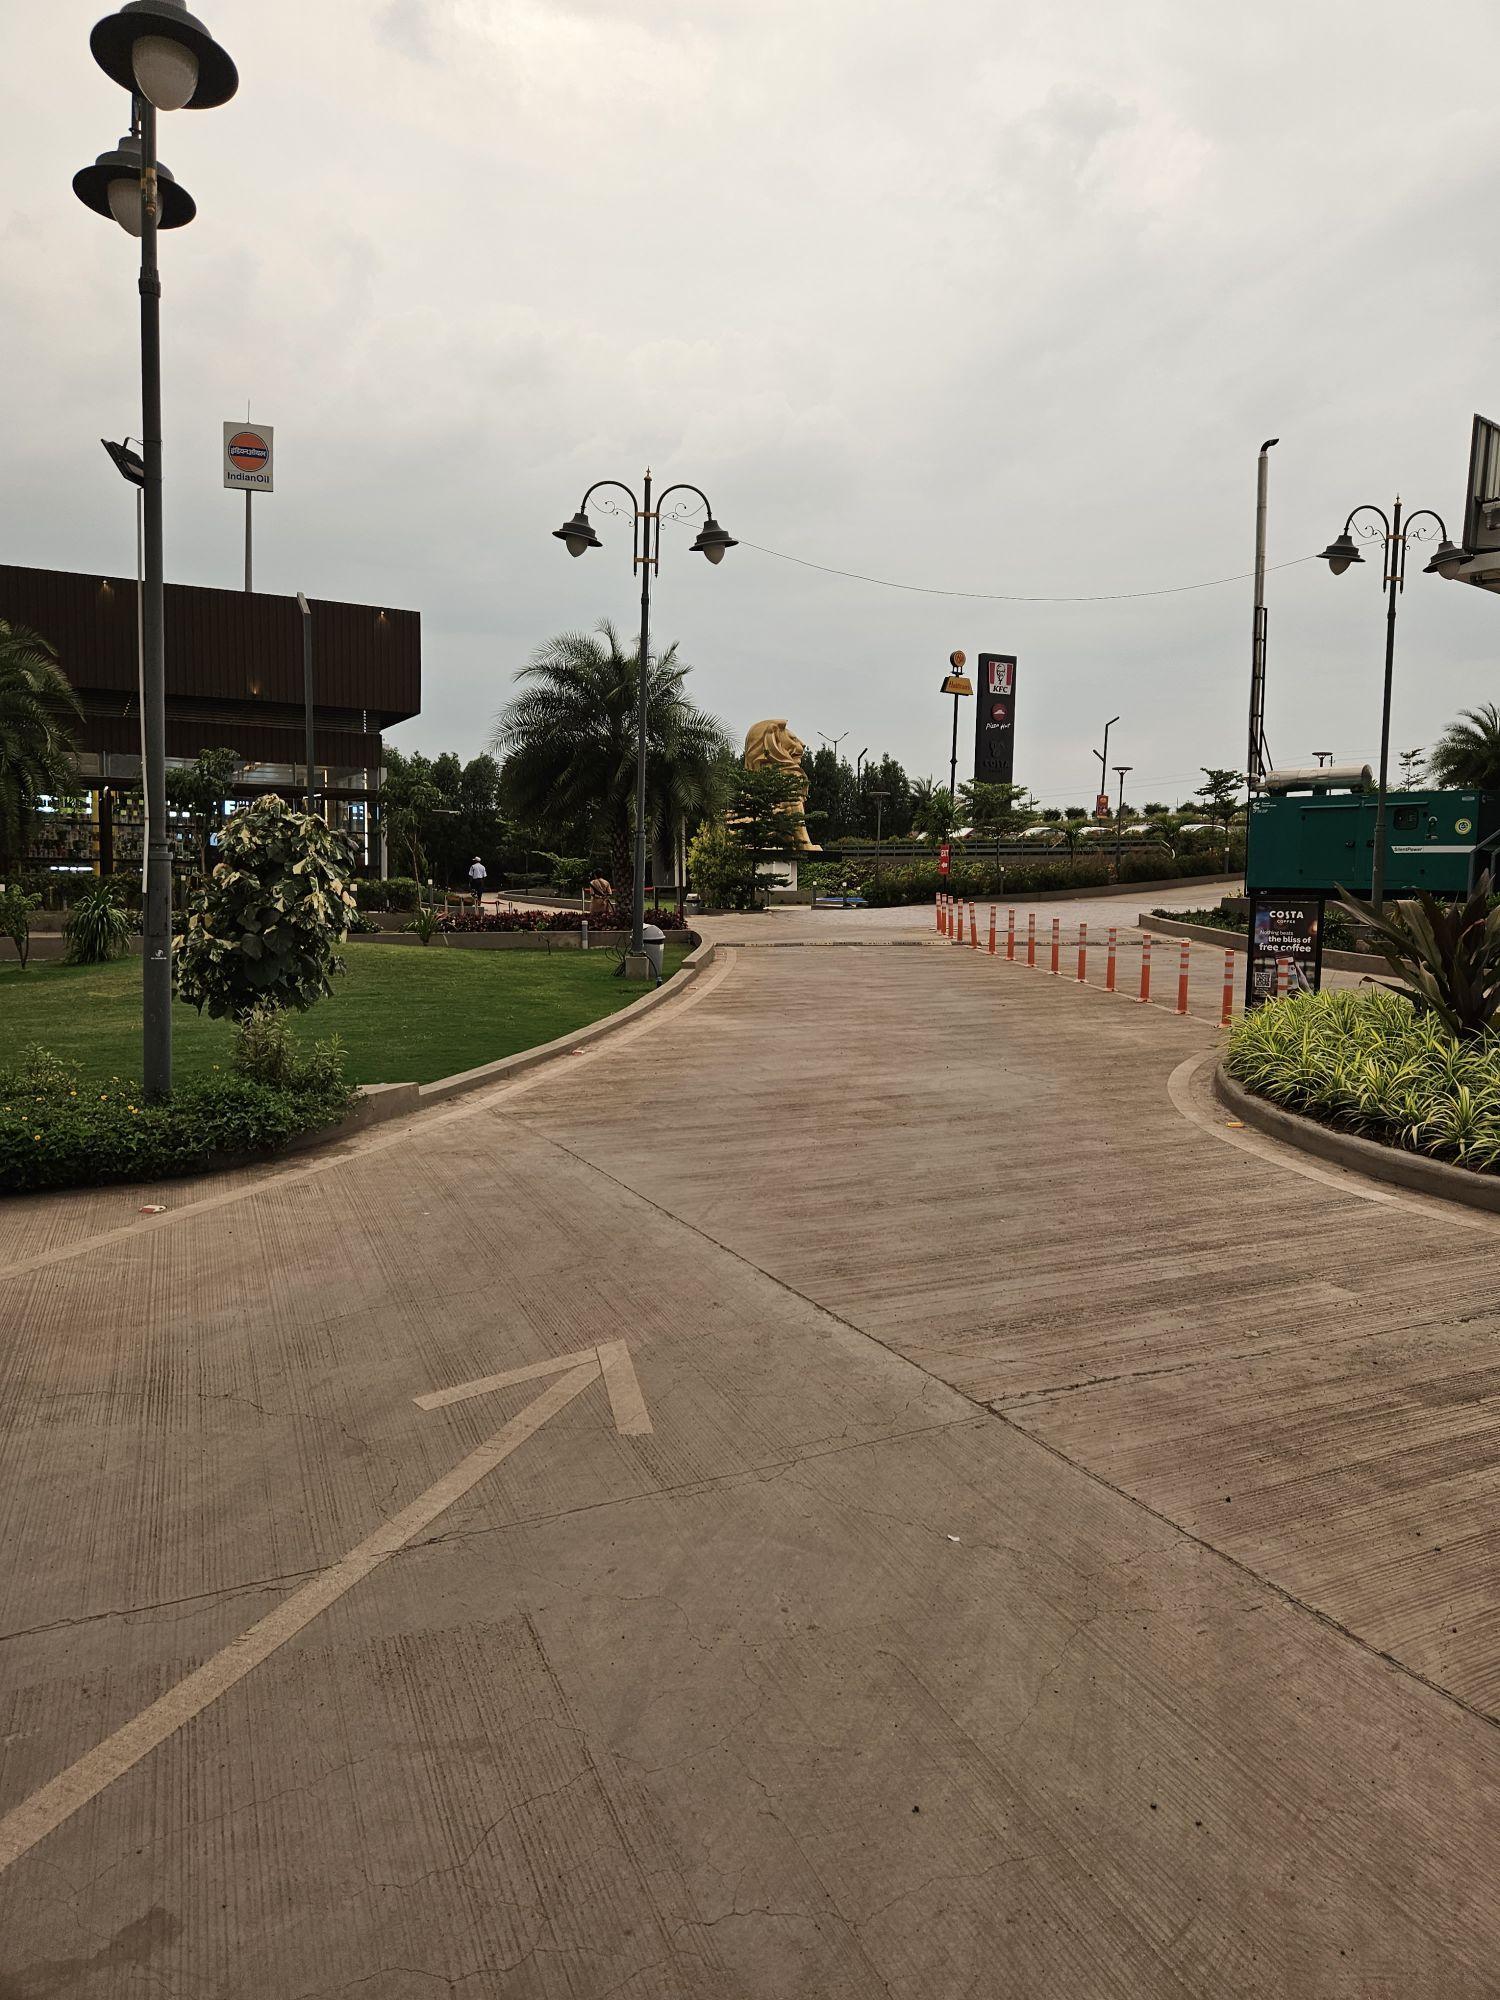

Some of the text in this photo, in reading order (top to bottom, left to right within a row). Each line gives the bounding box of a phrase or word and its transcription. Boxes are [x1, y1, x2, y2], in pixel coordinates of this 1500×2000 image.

[227, 472, 269, 483] IndianOil
[993, 685, 1008, 693] KFC
[985, 722, 1000, 731] Pizza
[1269, 910, 1304, 919] COSTA
[1268, 935, 1282, 943] the
[1302, 936, 1312, 944] of
[1259, 942, 1312, 953] free coffee
